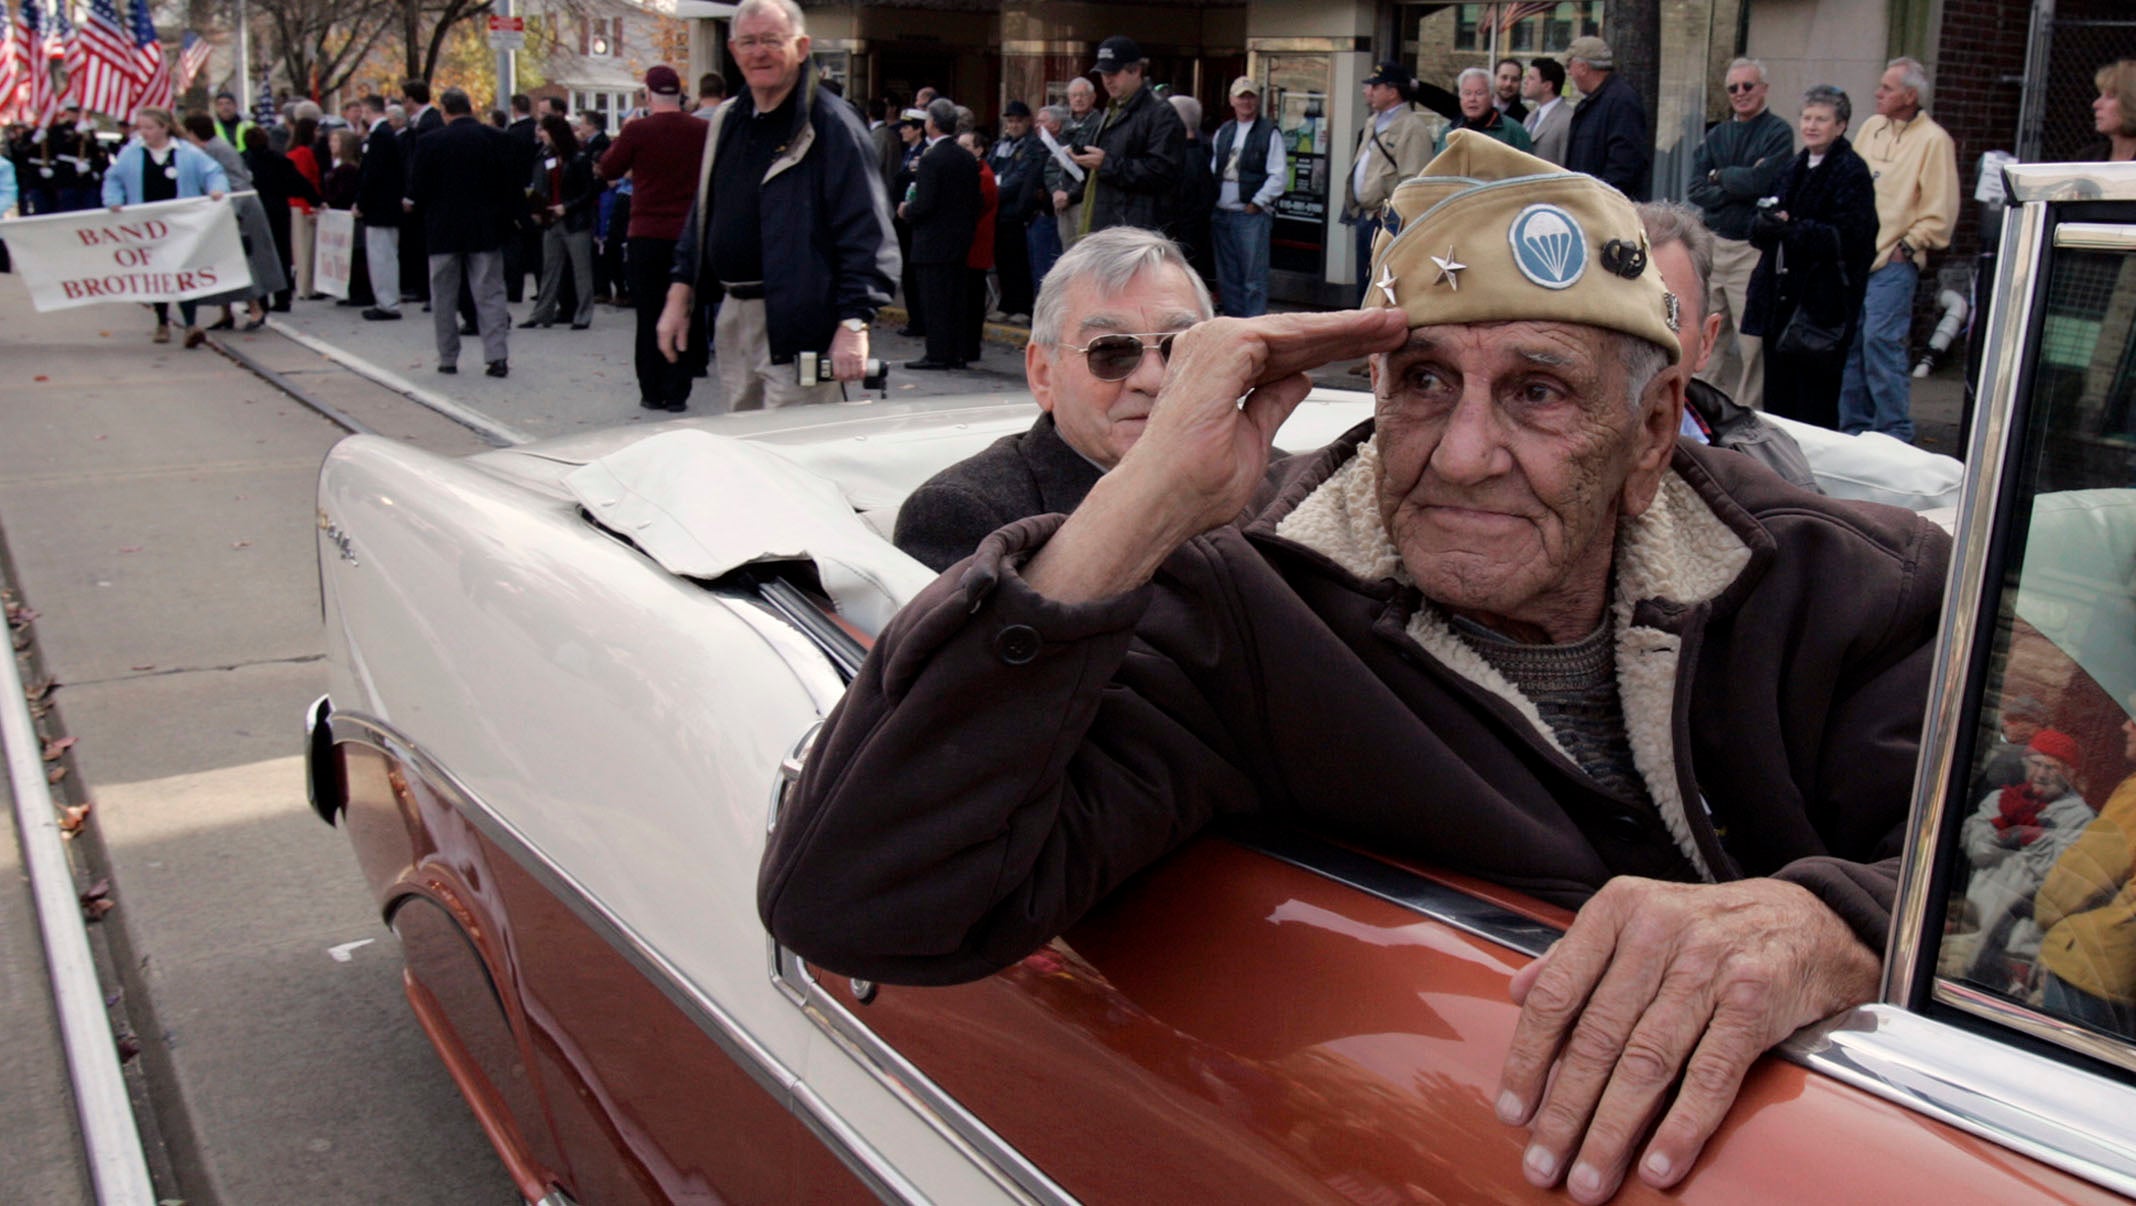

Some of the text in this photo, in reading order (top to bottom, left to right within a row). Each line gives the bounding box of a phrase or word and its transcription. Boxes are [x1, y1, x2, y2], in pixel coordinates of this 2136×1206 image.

[76, 220, 168, 246] BAND
[114, 248, 153, 267] OF
[61, 267, 217, 299] BROTHERS
